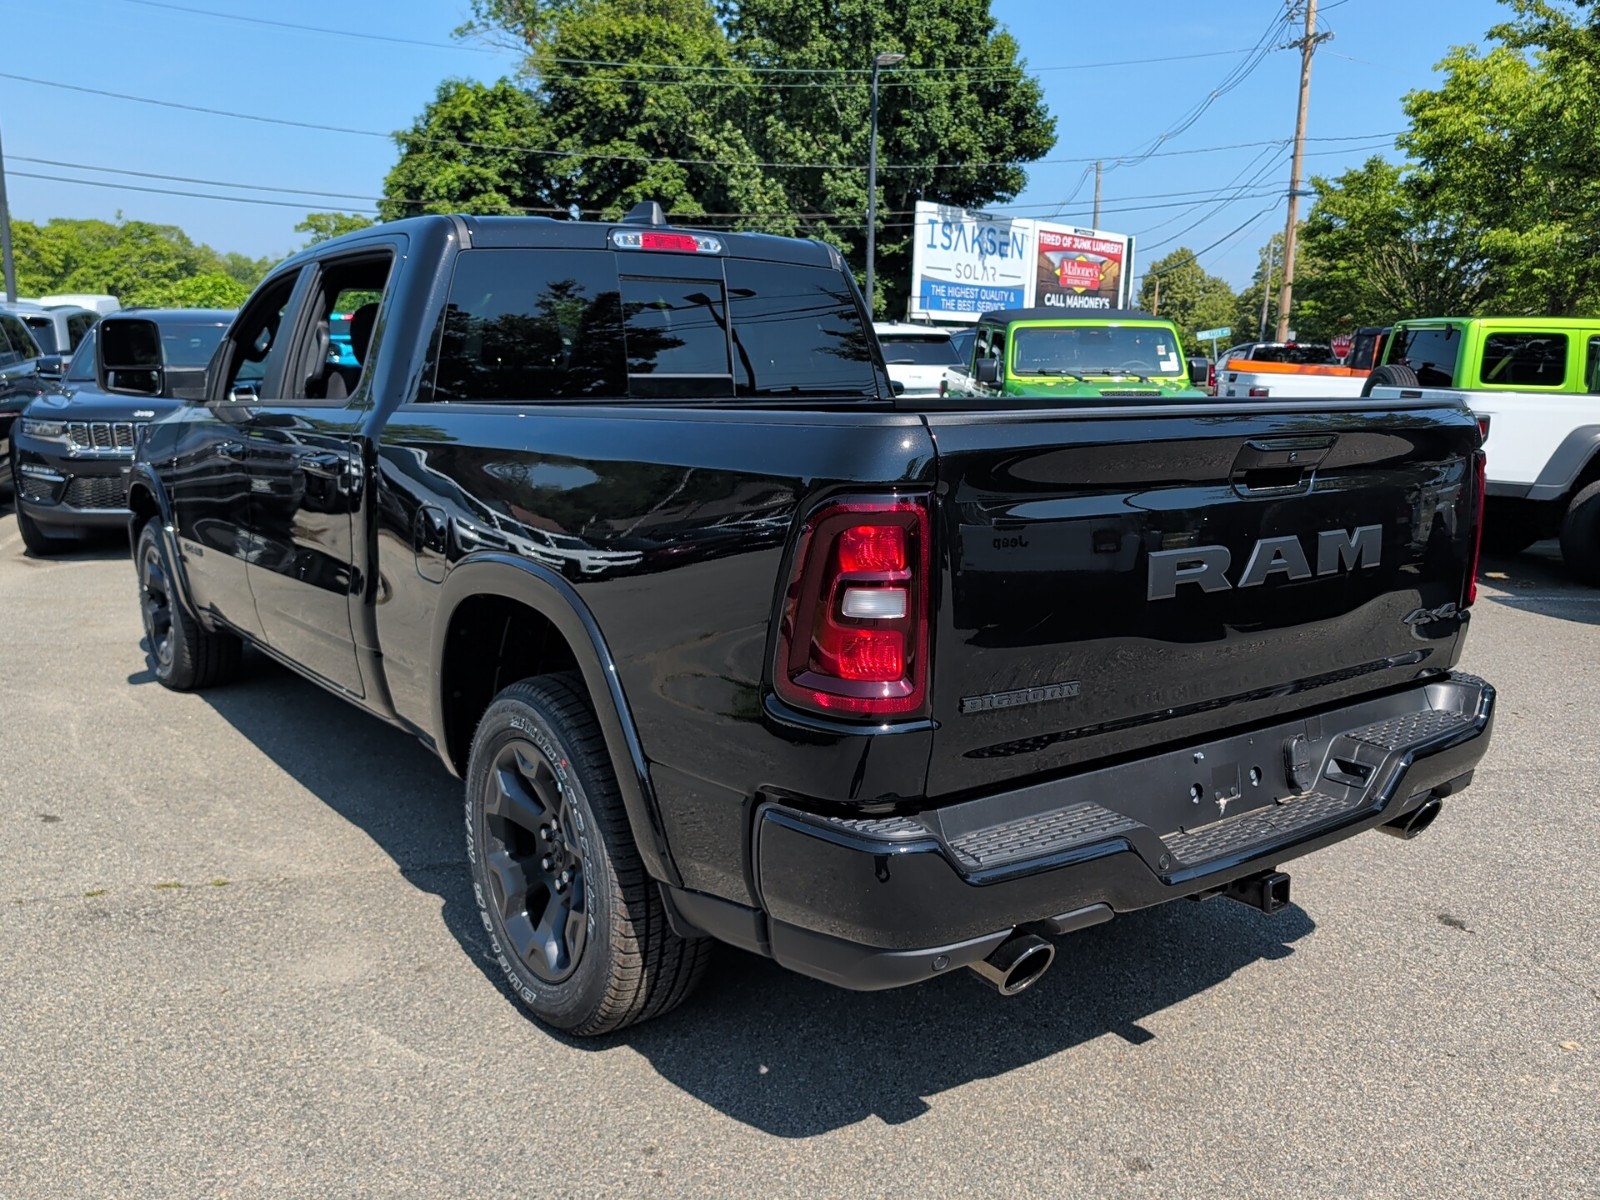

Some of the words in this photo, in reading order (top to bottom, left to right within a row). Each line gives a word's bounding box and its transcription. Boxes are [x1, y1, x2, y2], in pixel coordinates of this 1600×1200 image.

[927, 219, 1024, 260] ISAKSEN
[1040, 231, 1061, 246] TIRED
[1062, 235, 1073, 248] OF
[1073, 237, 1092, 250] JUNK
[1092, 240, 1122, 254] LUMBER?
[955, 263, 997, 282] SOLAR
[1063, 261, 1099, 277] Mahoney's
[931, 284, 947, 297] THE
[947, 286, 979, 299] HIGHEST
[981, 289, 1009, 302] QUALITY
[1009, 292, 1015, 303] &
[1044, 293, 1065, 307] CALL
[1066, 294, 1110, 309] MAHONEY'S
[941, 298, 956, 310] THE
[956, 299, 976, 312] BEST
[977, 301, 1006, 313] SERVICE
[1147, 524, 1383, 601] RAM
